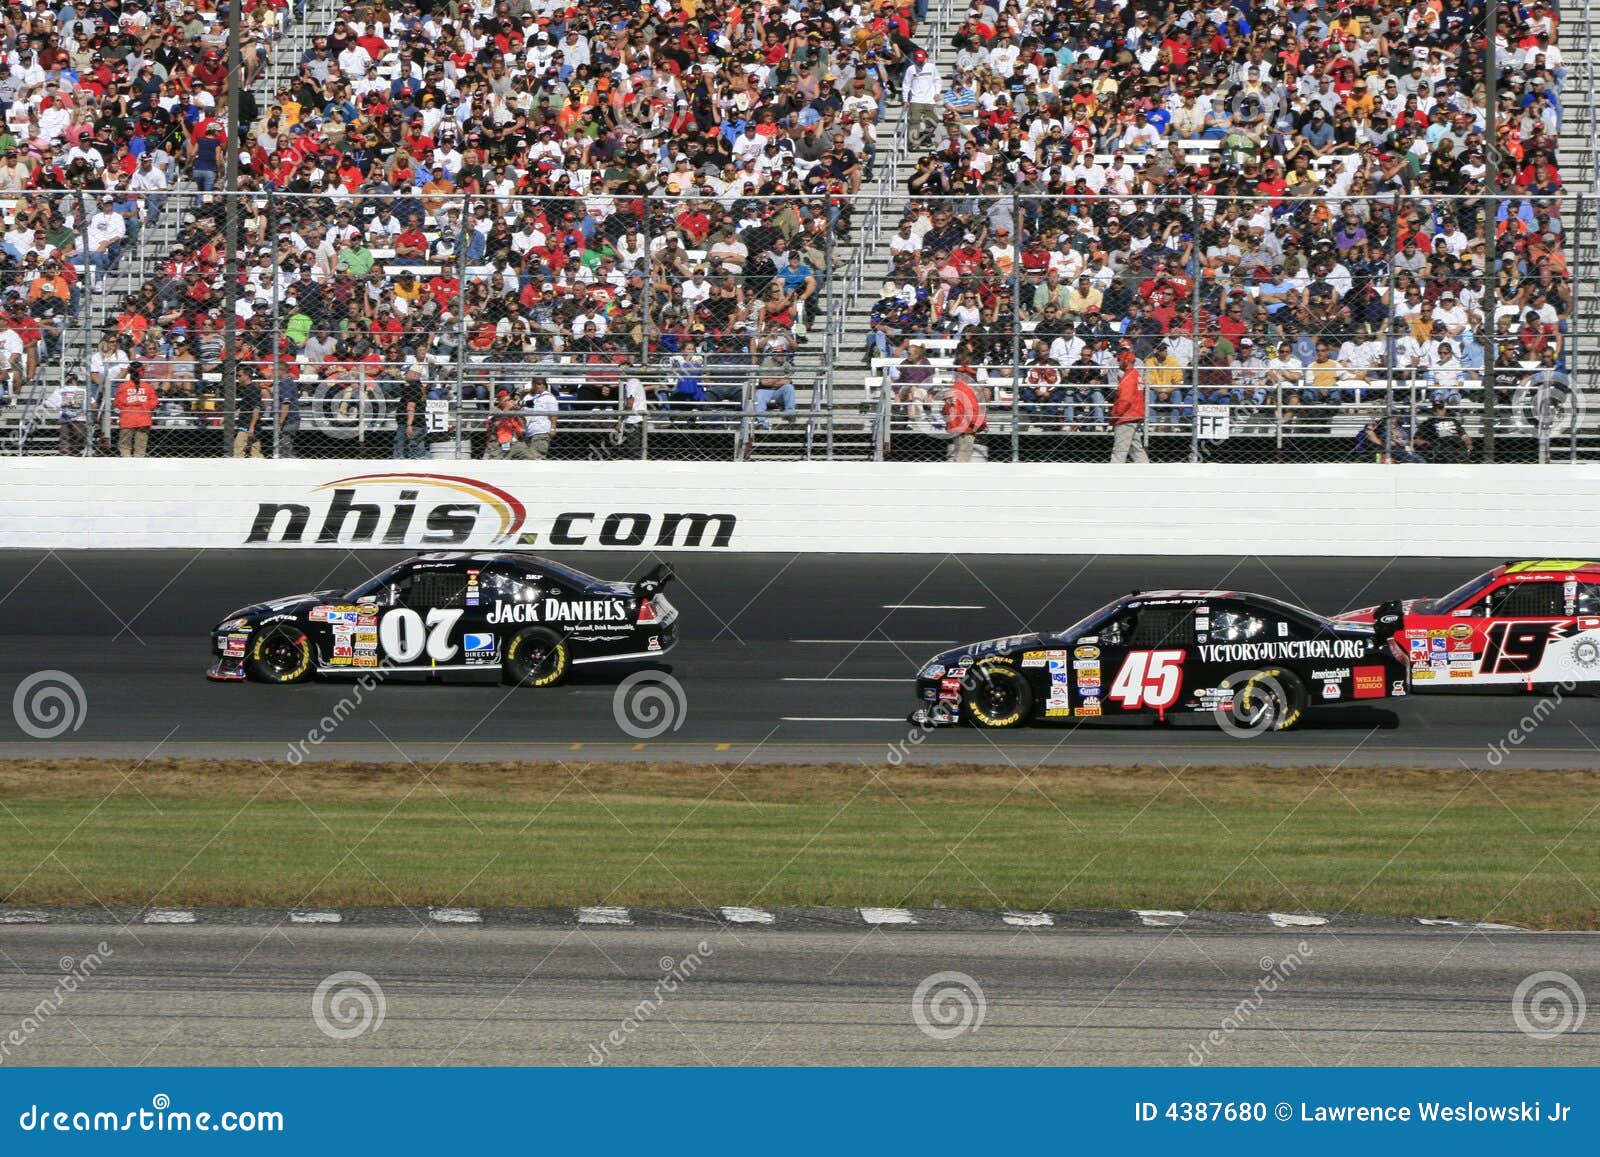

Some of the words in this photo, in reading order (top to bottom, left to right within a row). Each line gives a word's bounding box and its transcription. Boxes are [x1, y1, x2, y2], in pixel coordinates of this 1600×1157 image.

[1200, 416, 1224, 434] FF
[245, 489, 736, 546] nhis.com
[486, 599, 540, 624] JACK
[379, 607, 464, 664] 07
[1479, 621, 1552, 674] 19
[335, 647, 352, 656] 3M
[1197, 639, 1365, 663] VICTORYJUNCTION.ORG
[1412, 651, 1428, 660] 3M
[1109, 649, 1186, 711] 45
